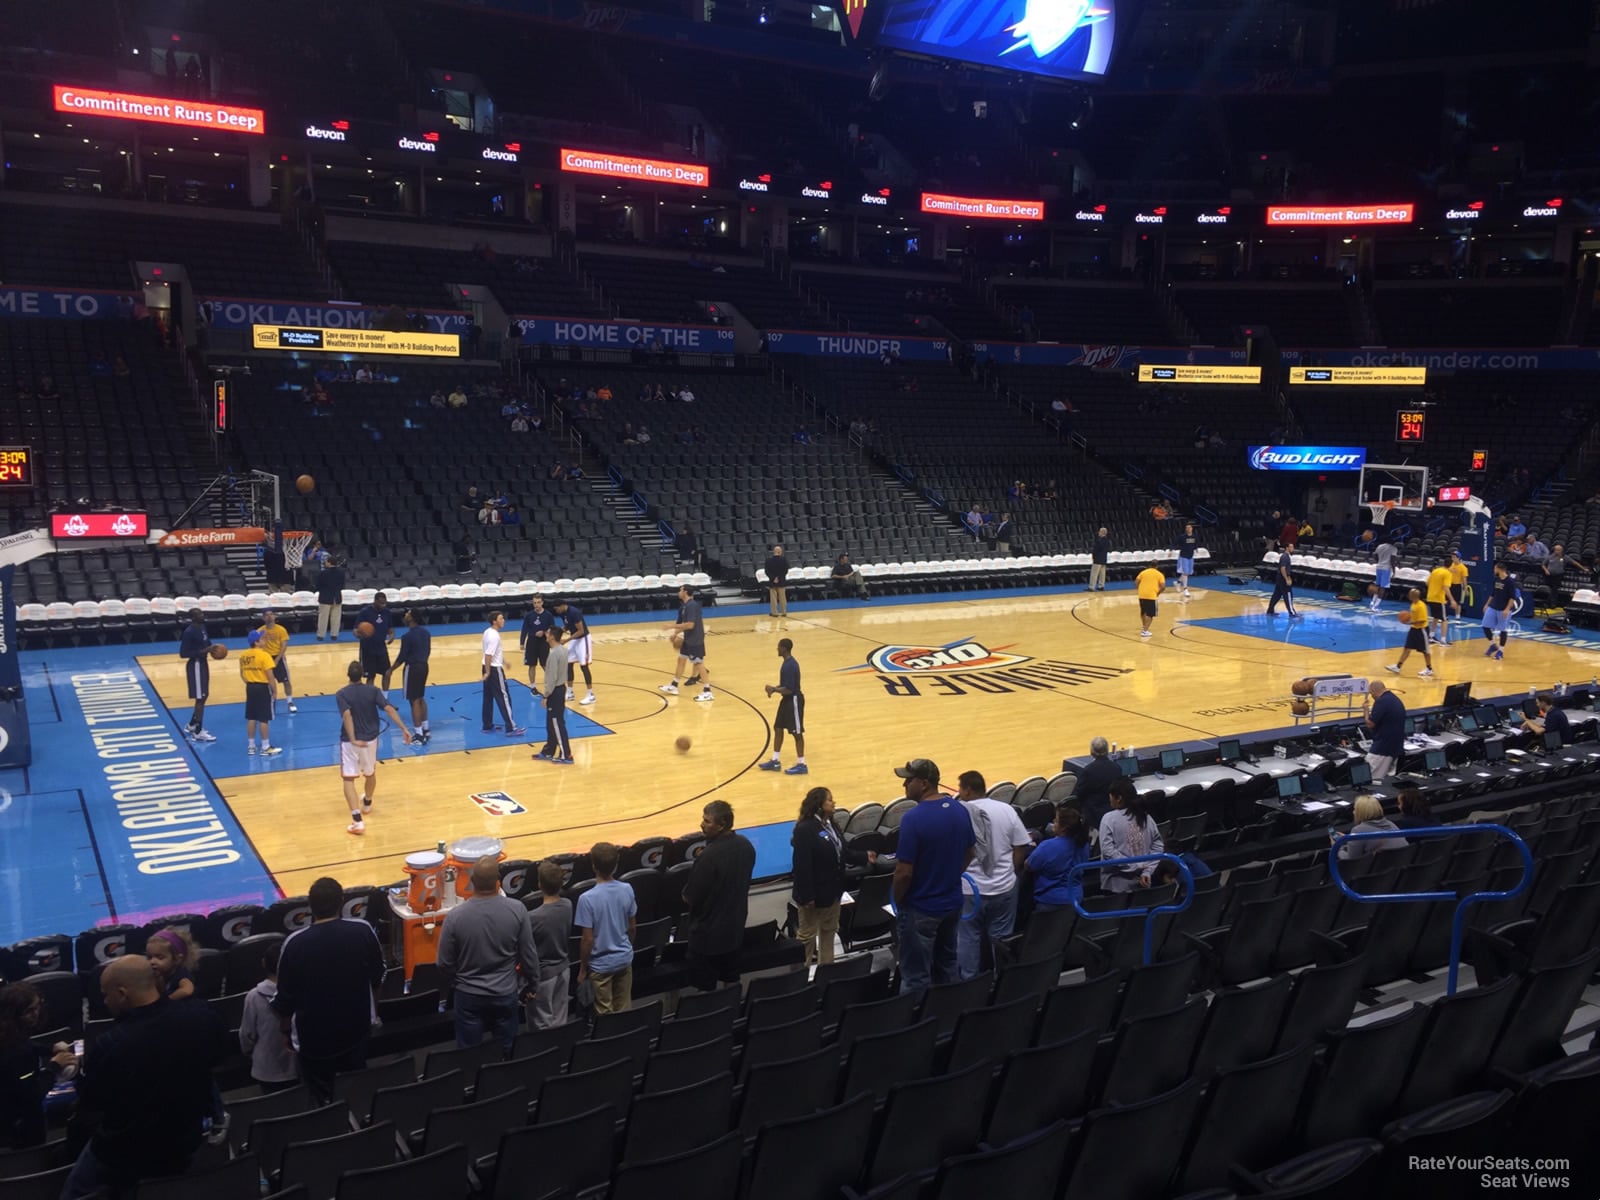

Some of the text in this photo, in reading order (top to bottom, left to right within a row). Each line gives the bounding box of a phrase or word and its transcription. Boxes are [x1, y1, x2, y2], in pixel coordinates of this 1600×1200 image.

[62, 92, 257, 129] Commitment Runs Deep
[306, 125, 345, 140] devon
[398, 137, 436, 151] devon
[482, 148, 518, 162] devon
[566, 154, 704, 184] Commitment Runs Deep
[739, 180, 768, 191] devon
[802, 187, 829, 199] devon
[861, 193, 887, 205] devon
[925, 197, 1039, 217] Commitment Runs Deep
[1446, 208, 1479, 220] devon
[1523, 206, 1557, 217] devon
[1075, 210, 1102, 221] devon
[1135, 213, 1163, 223] devon
[1197, 213, 1227, 223] devon
[1271, 208, 1407, 222] Commitment Runs Deep
[53, 294, 99, 316] TO
[225, 303, 373, 328] OKLAHOM
[325, 331, 339, 339] Save
[339, 333, 358, 342] energy
[554, 322, 700, 347] HOME OF THE
[717, 330, 734, 339] 106
[767, 333, 782, 342] 107
[412, 343, 434, 352] Building
[817, 336, 901, 356] THUNDER
[932, 341, 946, 350] 107
[1351, 351, 1540, 369] okcthunder.com
[1401, 414, 1423, 423] 53:09
[1402, 424, 1421, 439] 24
[1260, 452, 1360, 464] BUD LIGHT
[0, 466, 21, 480] 24
[903, 642, 991, 669] OKC
[876, 660, 1135, 697] THUNDER
[71, 671, 241, 875] OKLAHOMA CITY THUNDER
[641, 846, 664, 869] G
[424, 875, 437, 889] G
[502, 868, 527, 895] G
